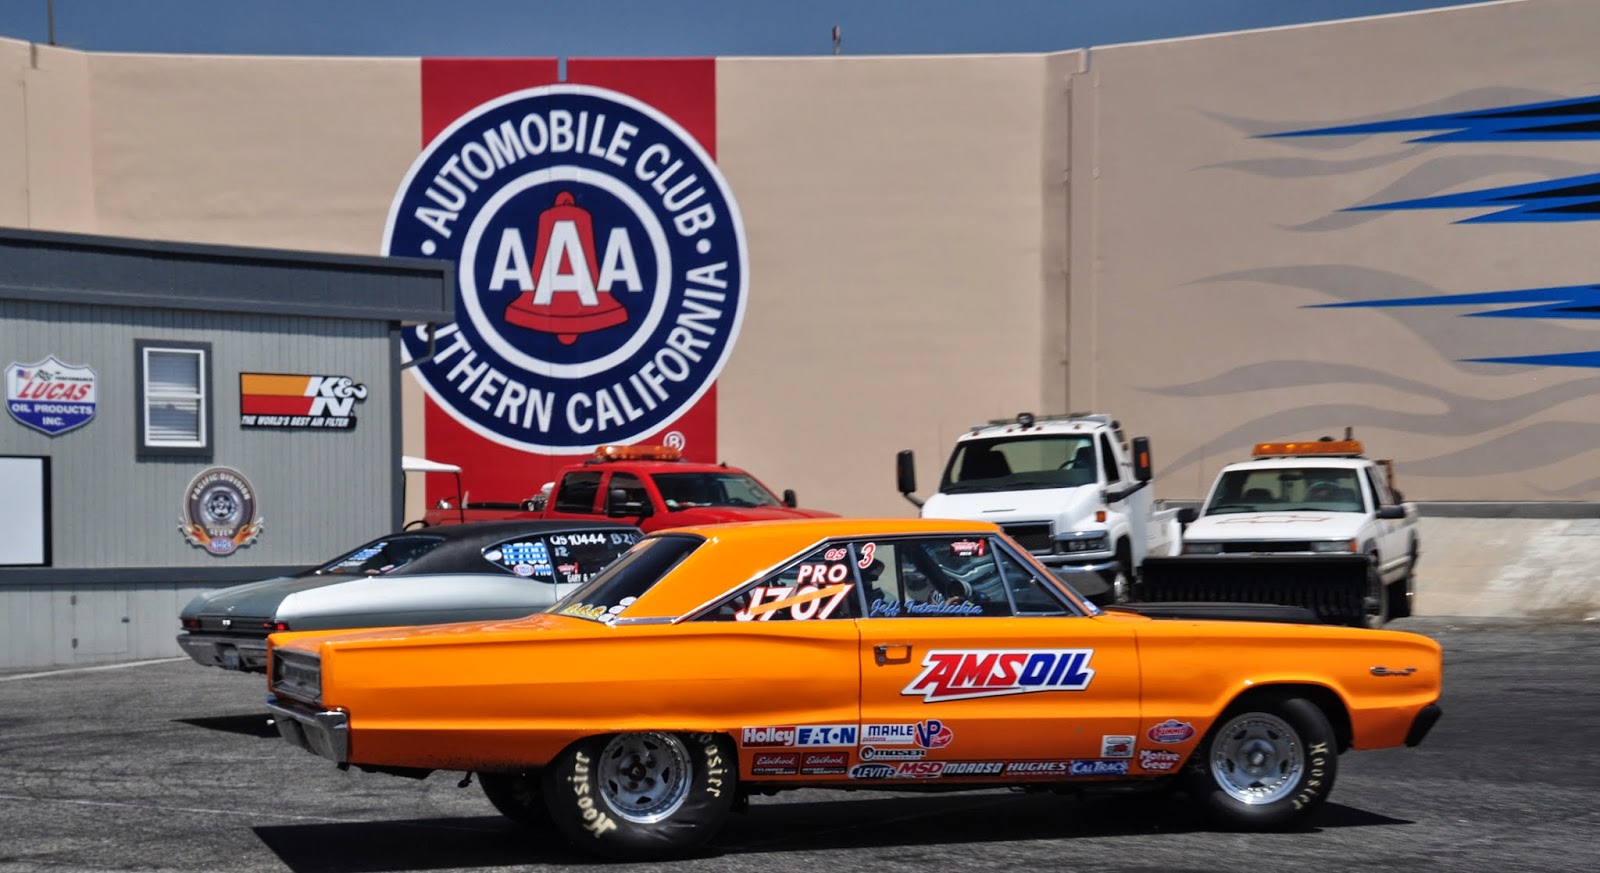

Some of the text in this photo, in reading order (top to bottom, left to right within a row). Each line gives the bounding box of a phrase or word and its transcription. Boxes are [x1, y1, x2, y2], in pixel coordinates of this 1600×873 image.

[415, 110, 717, 239] AUTOMOBILE CLUB
[489, 220, 643, 307] AAA
[416, 261, 728, 434] UTHERN CALIFORNIA
[17, 380, 92, 401] LUCAS
[11, 403, 93, 415] OIL PRODUCTS
[42, 416, 66, 426] INC.
[241, 415, 350, 428] THE WORLD'S BEST AIR FILTER
[191, 473, 251, 500] PACIFIC DIVISION
[568, 533, 606, 546] 10444
[824, 548, 847, 561] QS
[858, 542, 876, 569] 3
[796, 564, 848, 585] PRO
[870, 598, 900, 618] Jeff
[911, 652, 1091, 698] AMSOIL
[743, 727, 856, 746] Holley EATON
[868, 725, 914, 736] MAHLE
[917, 720, 942, 748] VP
[1139, 749, 1180, 760] Motive
[698, 732, 728, 798] oosier
[899, 762, 943, 774] MSD
[943, 762, 1004, 773] MOROSO
[1007, 761, 1068, 771] HUGHES
[1141, 760, 1174, 770] Gear
[1291, 741, 1329, 810] Hoosier
